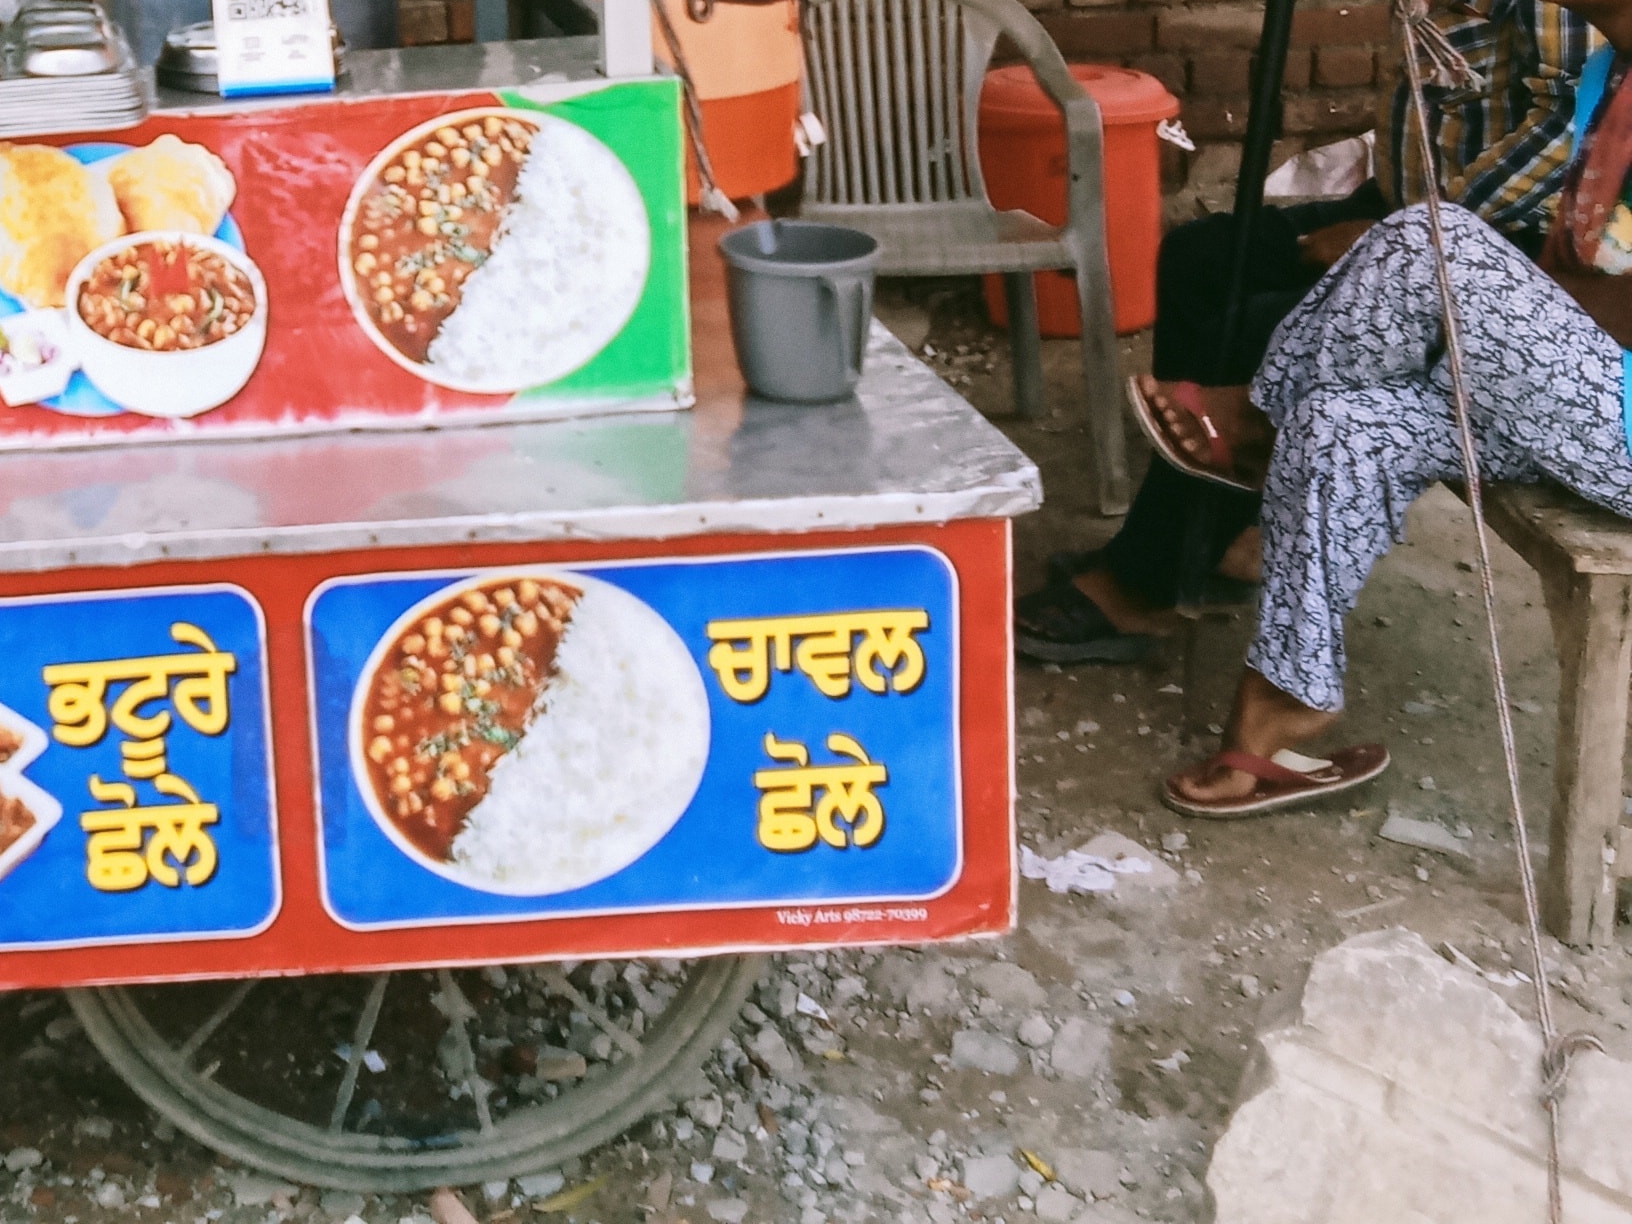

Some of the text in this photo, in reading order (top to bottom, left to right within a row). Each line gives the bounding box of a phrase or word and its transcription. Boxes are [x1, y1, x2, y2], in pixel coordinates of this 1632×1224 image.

[42, 621, 238, 778] ਭਟੂਰੇ
[706, 609, 931, 704] ਚਾਵਲ
[79, 772, 220, 894] ਛੋਲੇ
[754, 731, 889, 853] ਛੋਲੇ
[776, 909, 812, 926] Vicky
[814, 908, 842, 923] Arts
